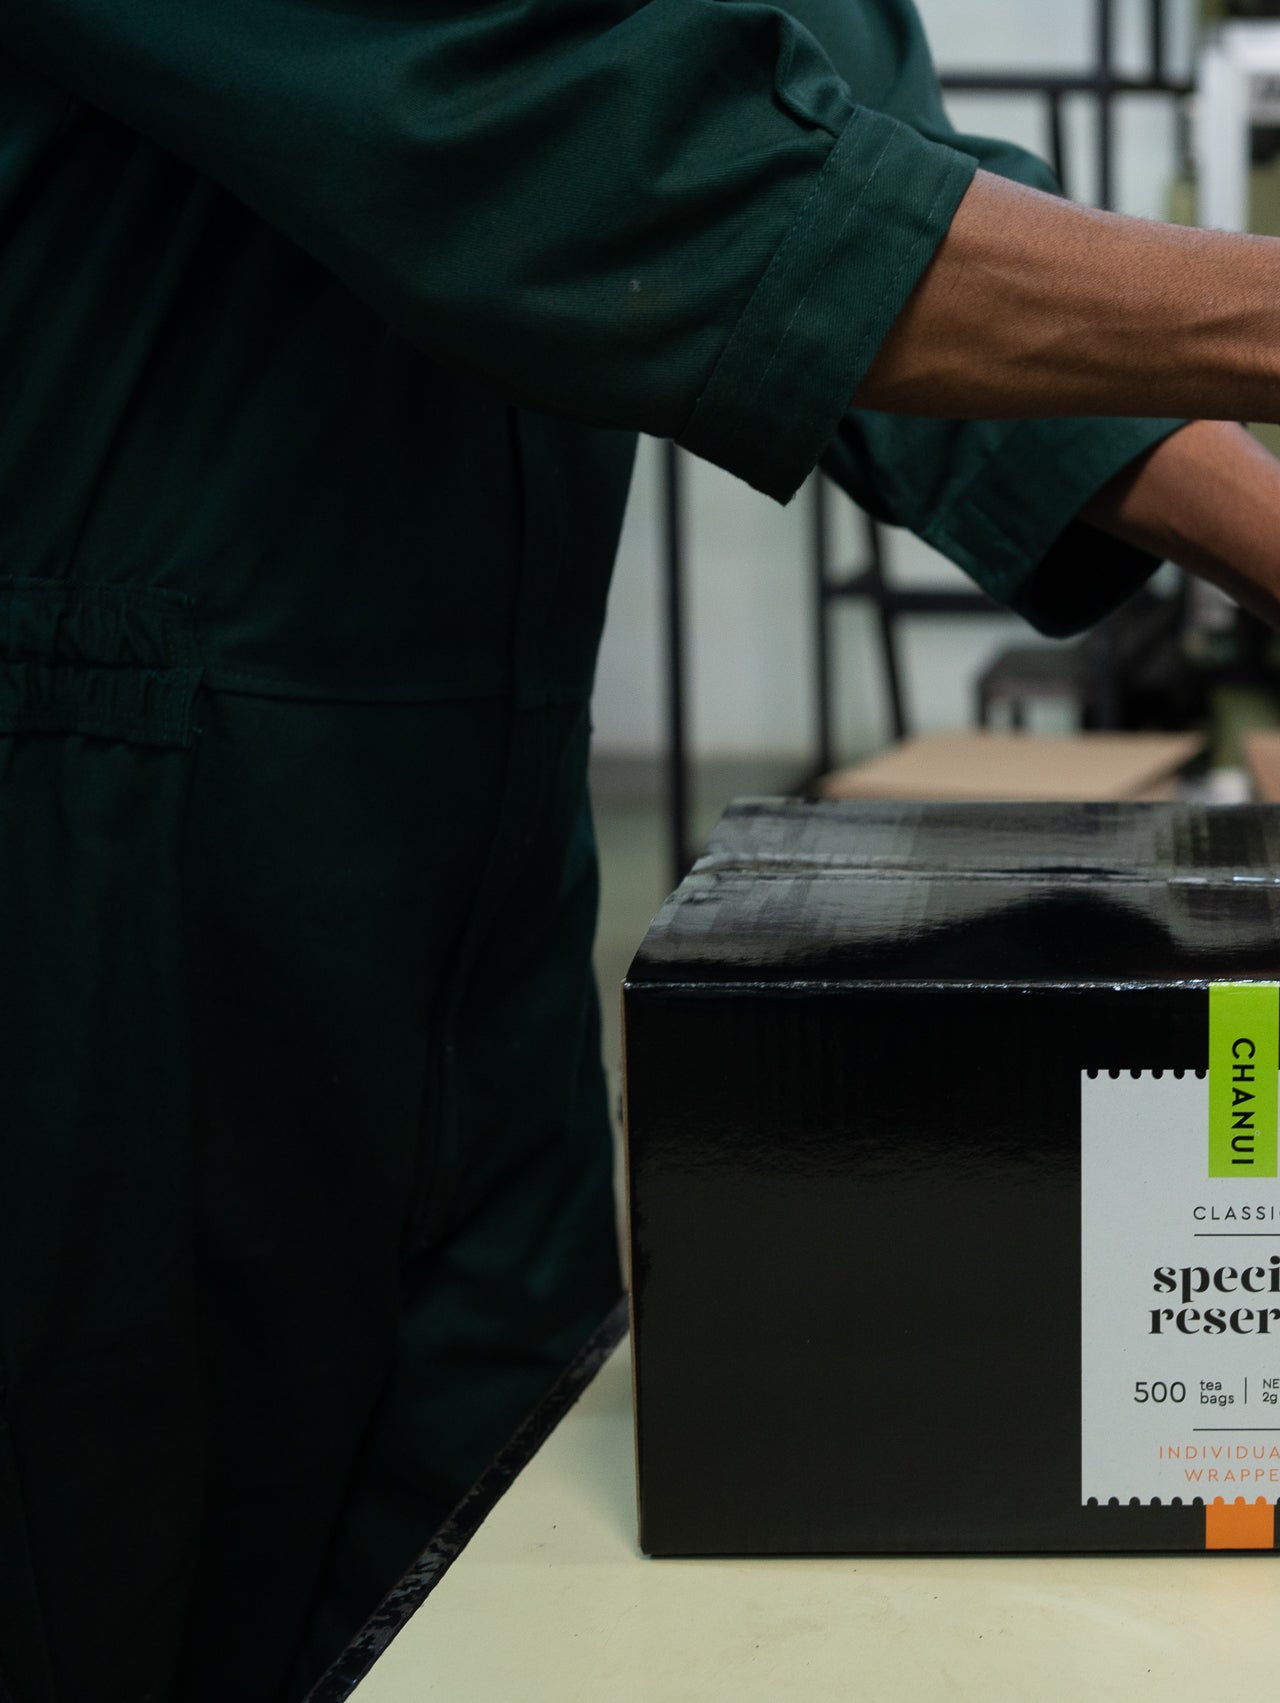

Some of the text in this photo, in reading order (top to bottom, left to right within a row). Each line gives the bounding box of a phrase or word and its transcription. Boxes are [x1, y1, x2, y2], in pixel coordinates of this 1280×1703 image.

[1230, 1037, 1256, 1166] CHANUI
[1133, 1381, 1187, 1404] 500
[1199, 1379, 1223, 1391] tea
[1200, 1391, 1235, 1407] bags
[1262, 1391, 1278, 1405] 2g
